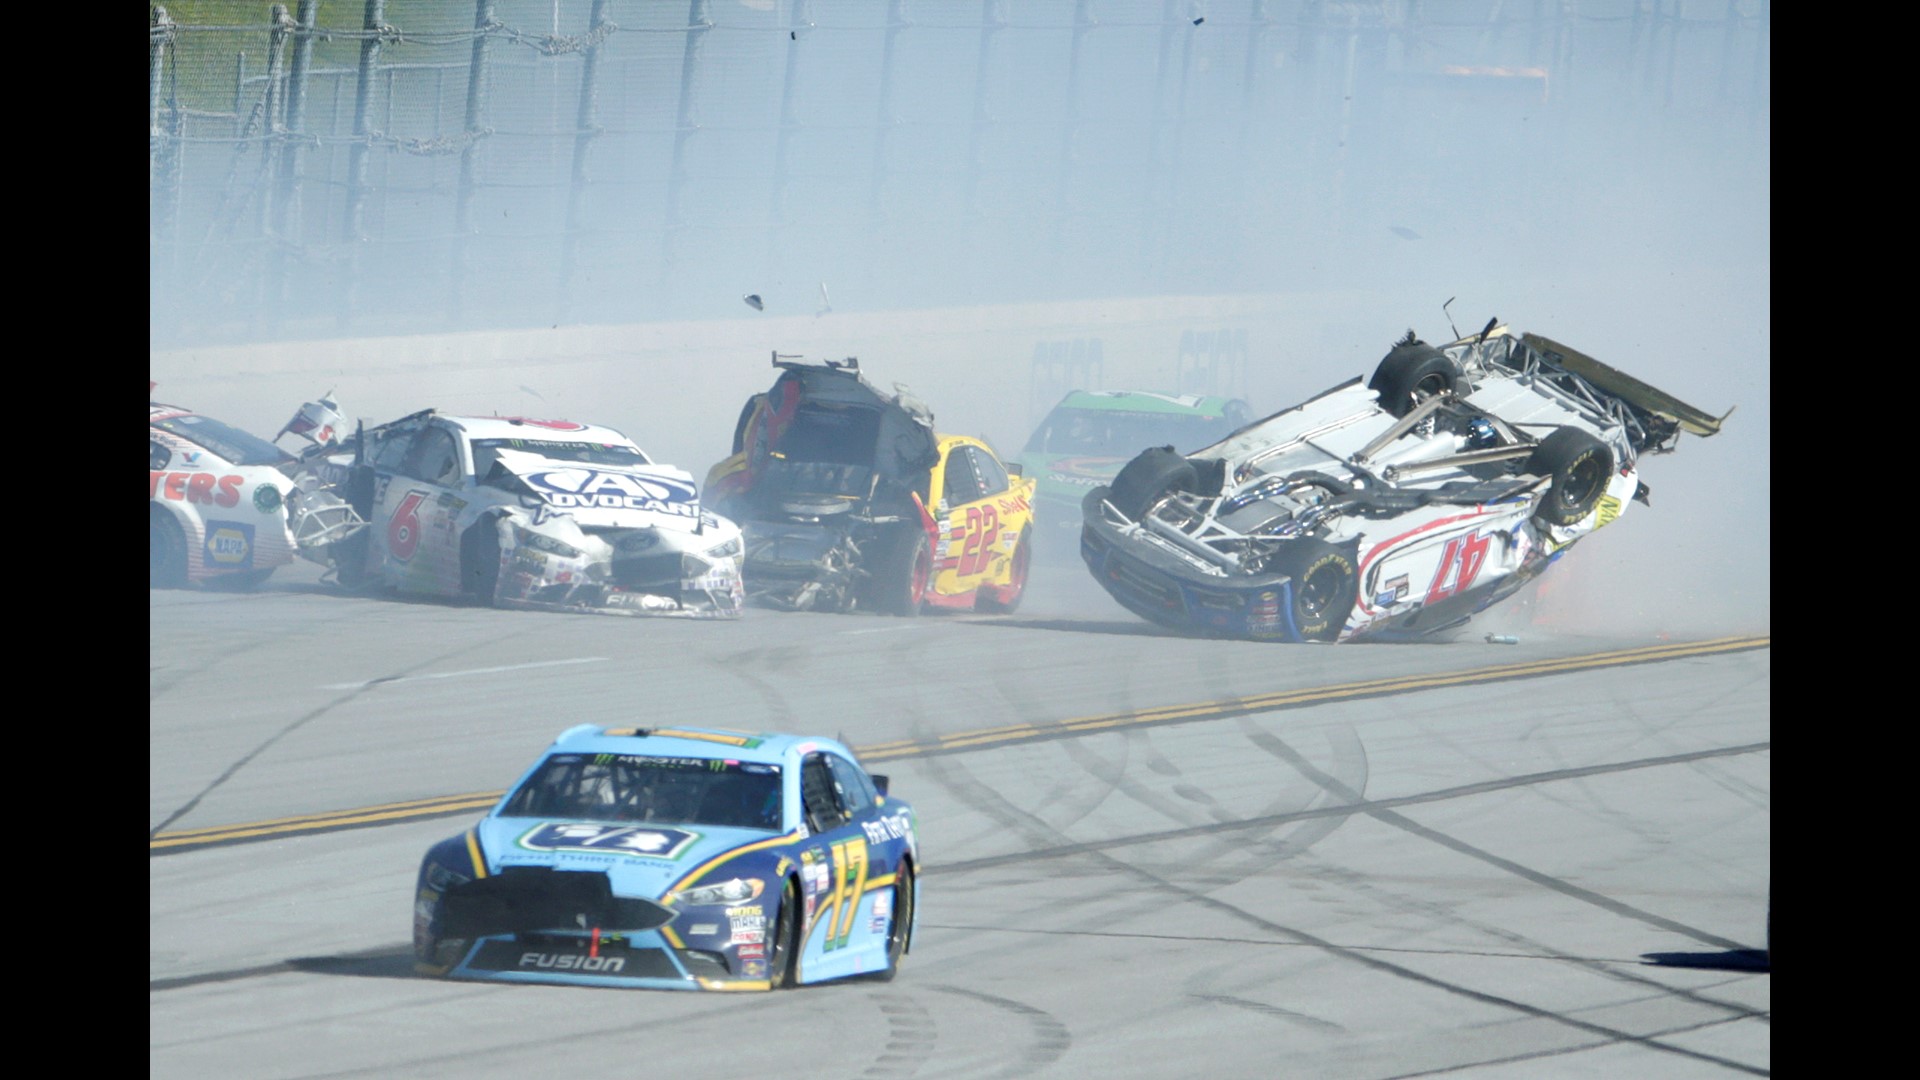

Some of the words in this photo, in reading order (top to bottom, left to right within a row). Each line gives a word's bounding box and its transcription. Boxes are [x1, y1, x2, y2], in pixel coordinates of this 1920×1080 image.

[216, 537, 243, 555] NAPA
[387, 489, 431, 563] 6
[957, 504, 1000, 577] 22
[1423, 529, 1493, 606] 47
[617, 755, 704, 767] MONSTER
[823, 834, 870, 952] 17
[518, 953, 625, 972] FUSION
